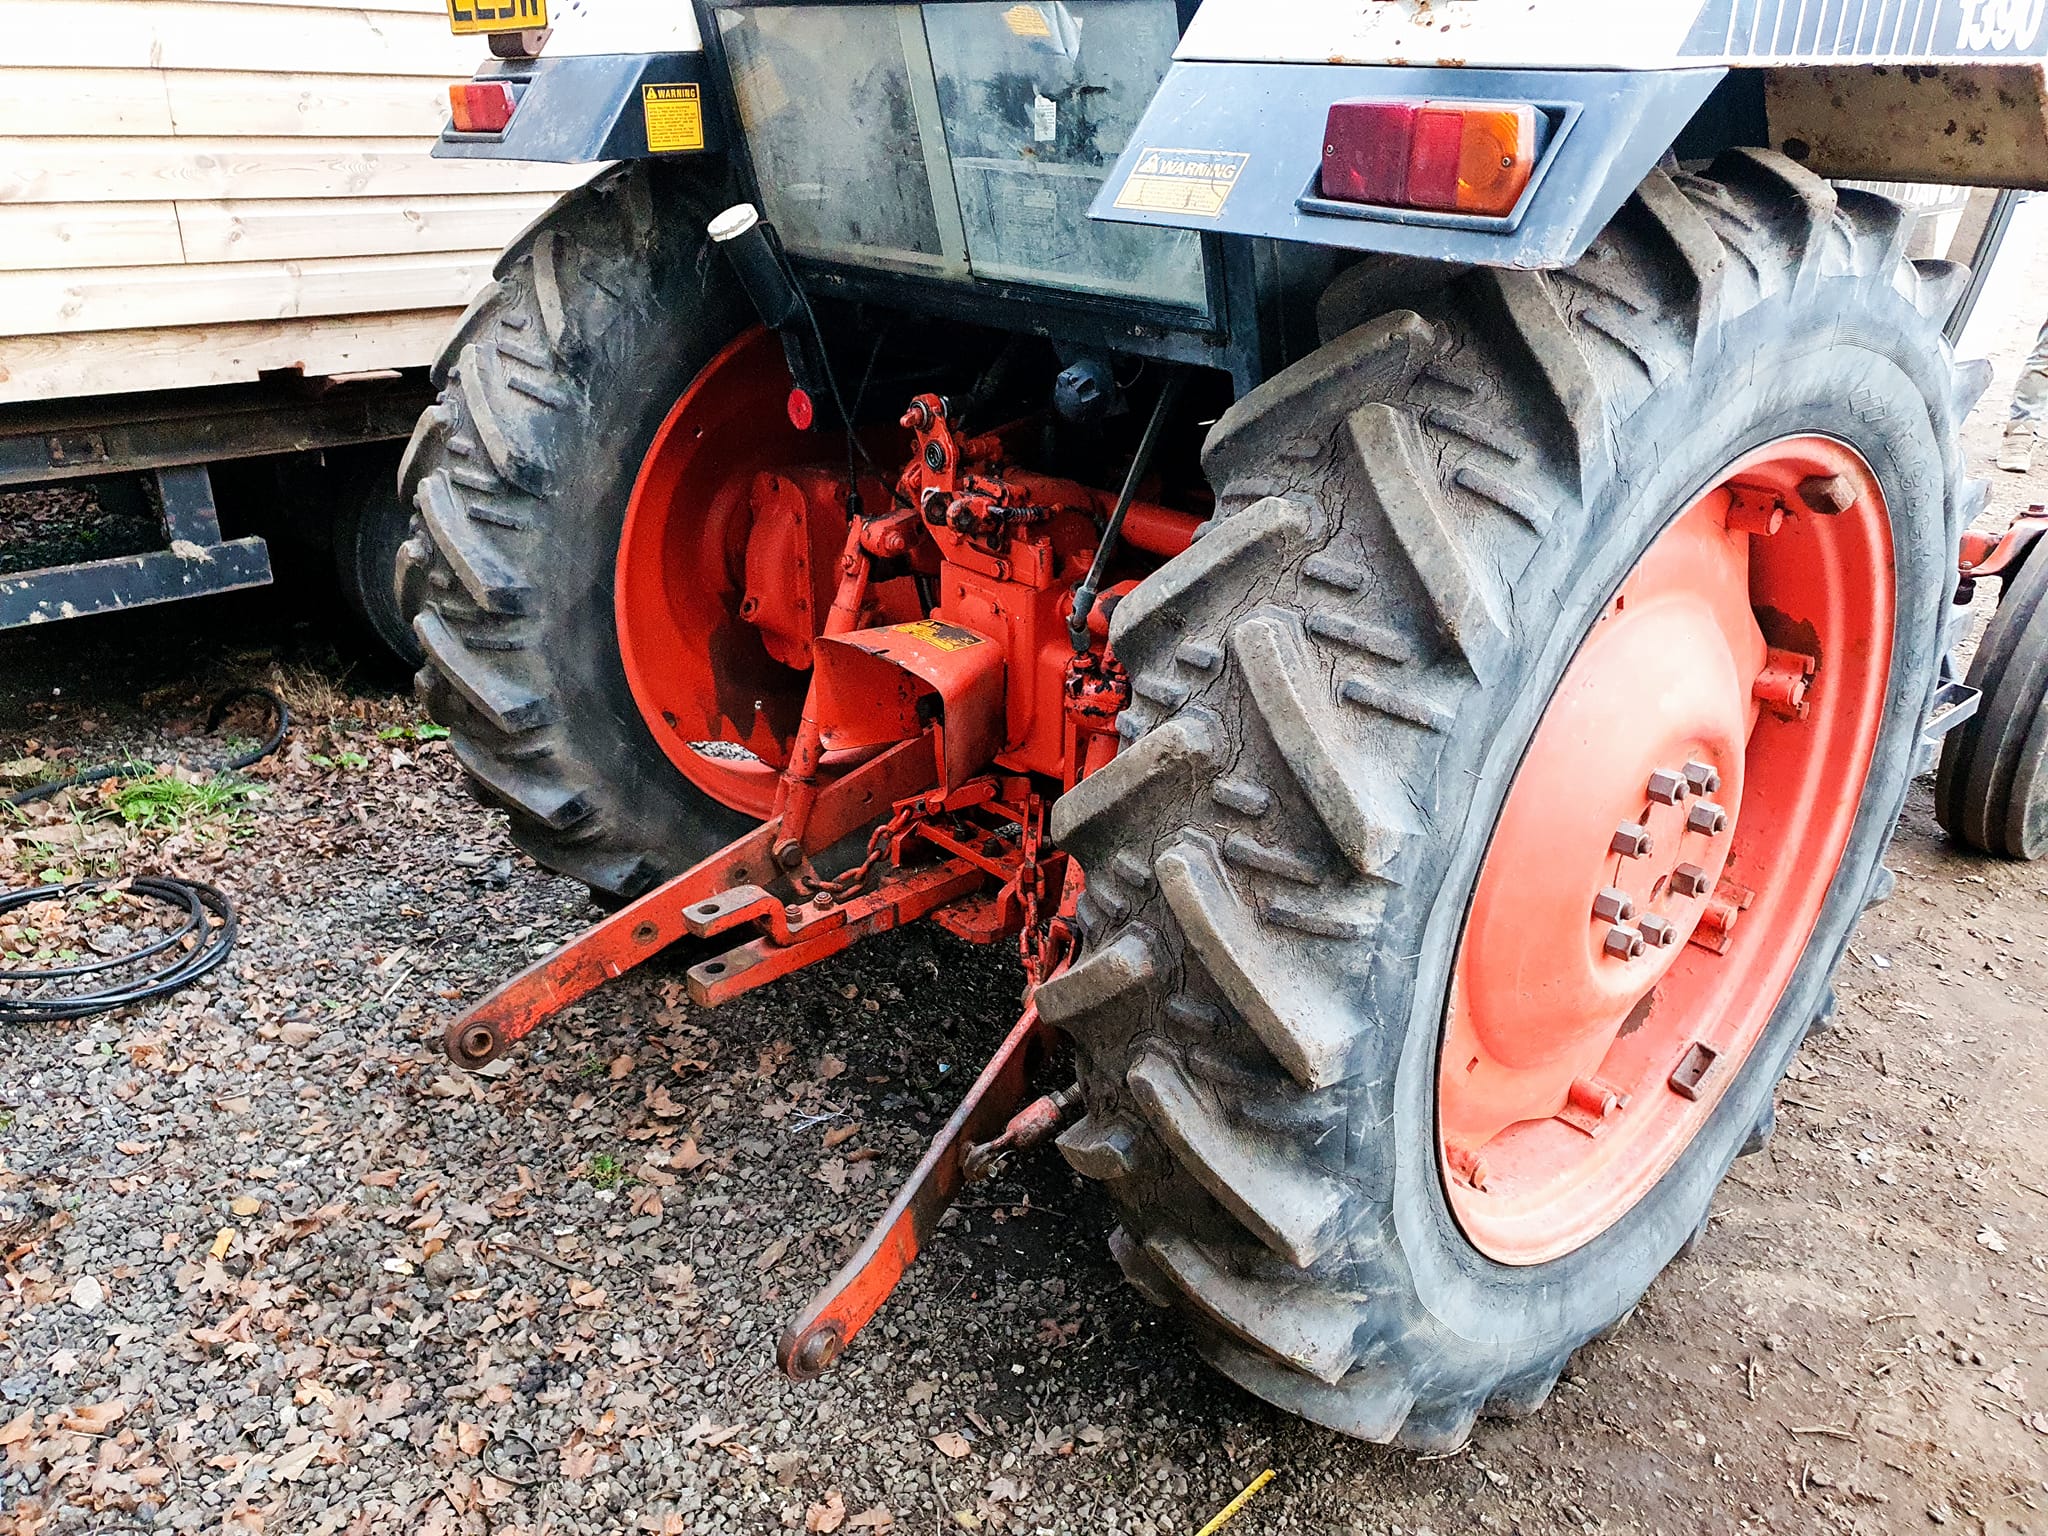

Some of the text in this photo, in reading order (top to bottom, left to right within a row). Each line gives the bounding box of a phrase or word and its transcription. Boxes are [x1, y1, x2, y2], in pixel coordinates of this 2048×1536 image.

[1956, 0, 2045, 51] 1390
[657, 88, 696, 99] WARNING
[1158, 159, 1237, 179] WARNING
